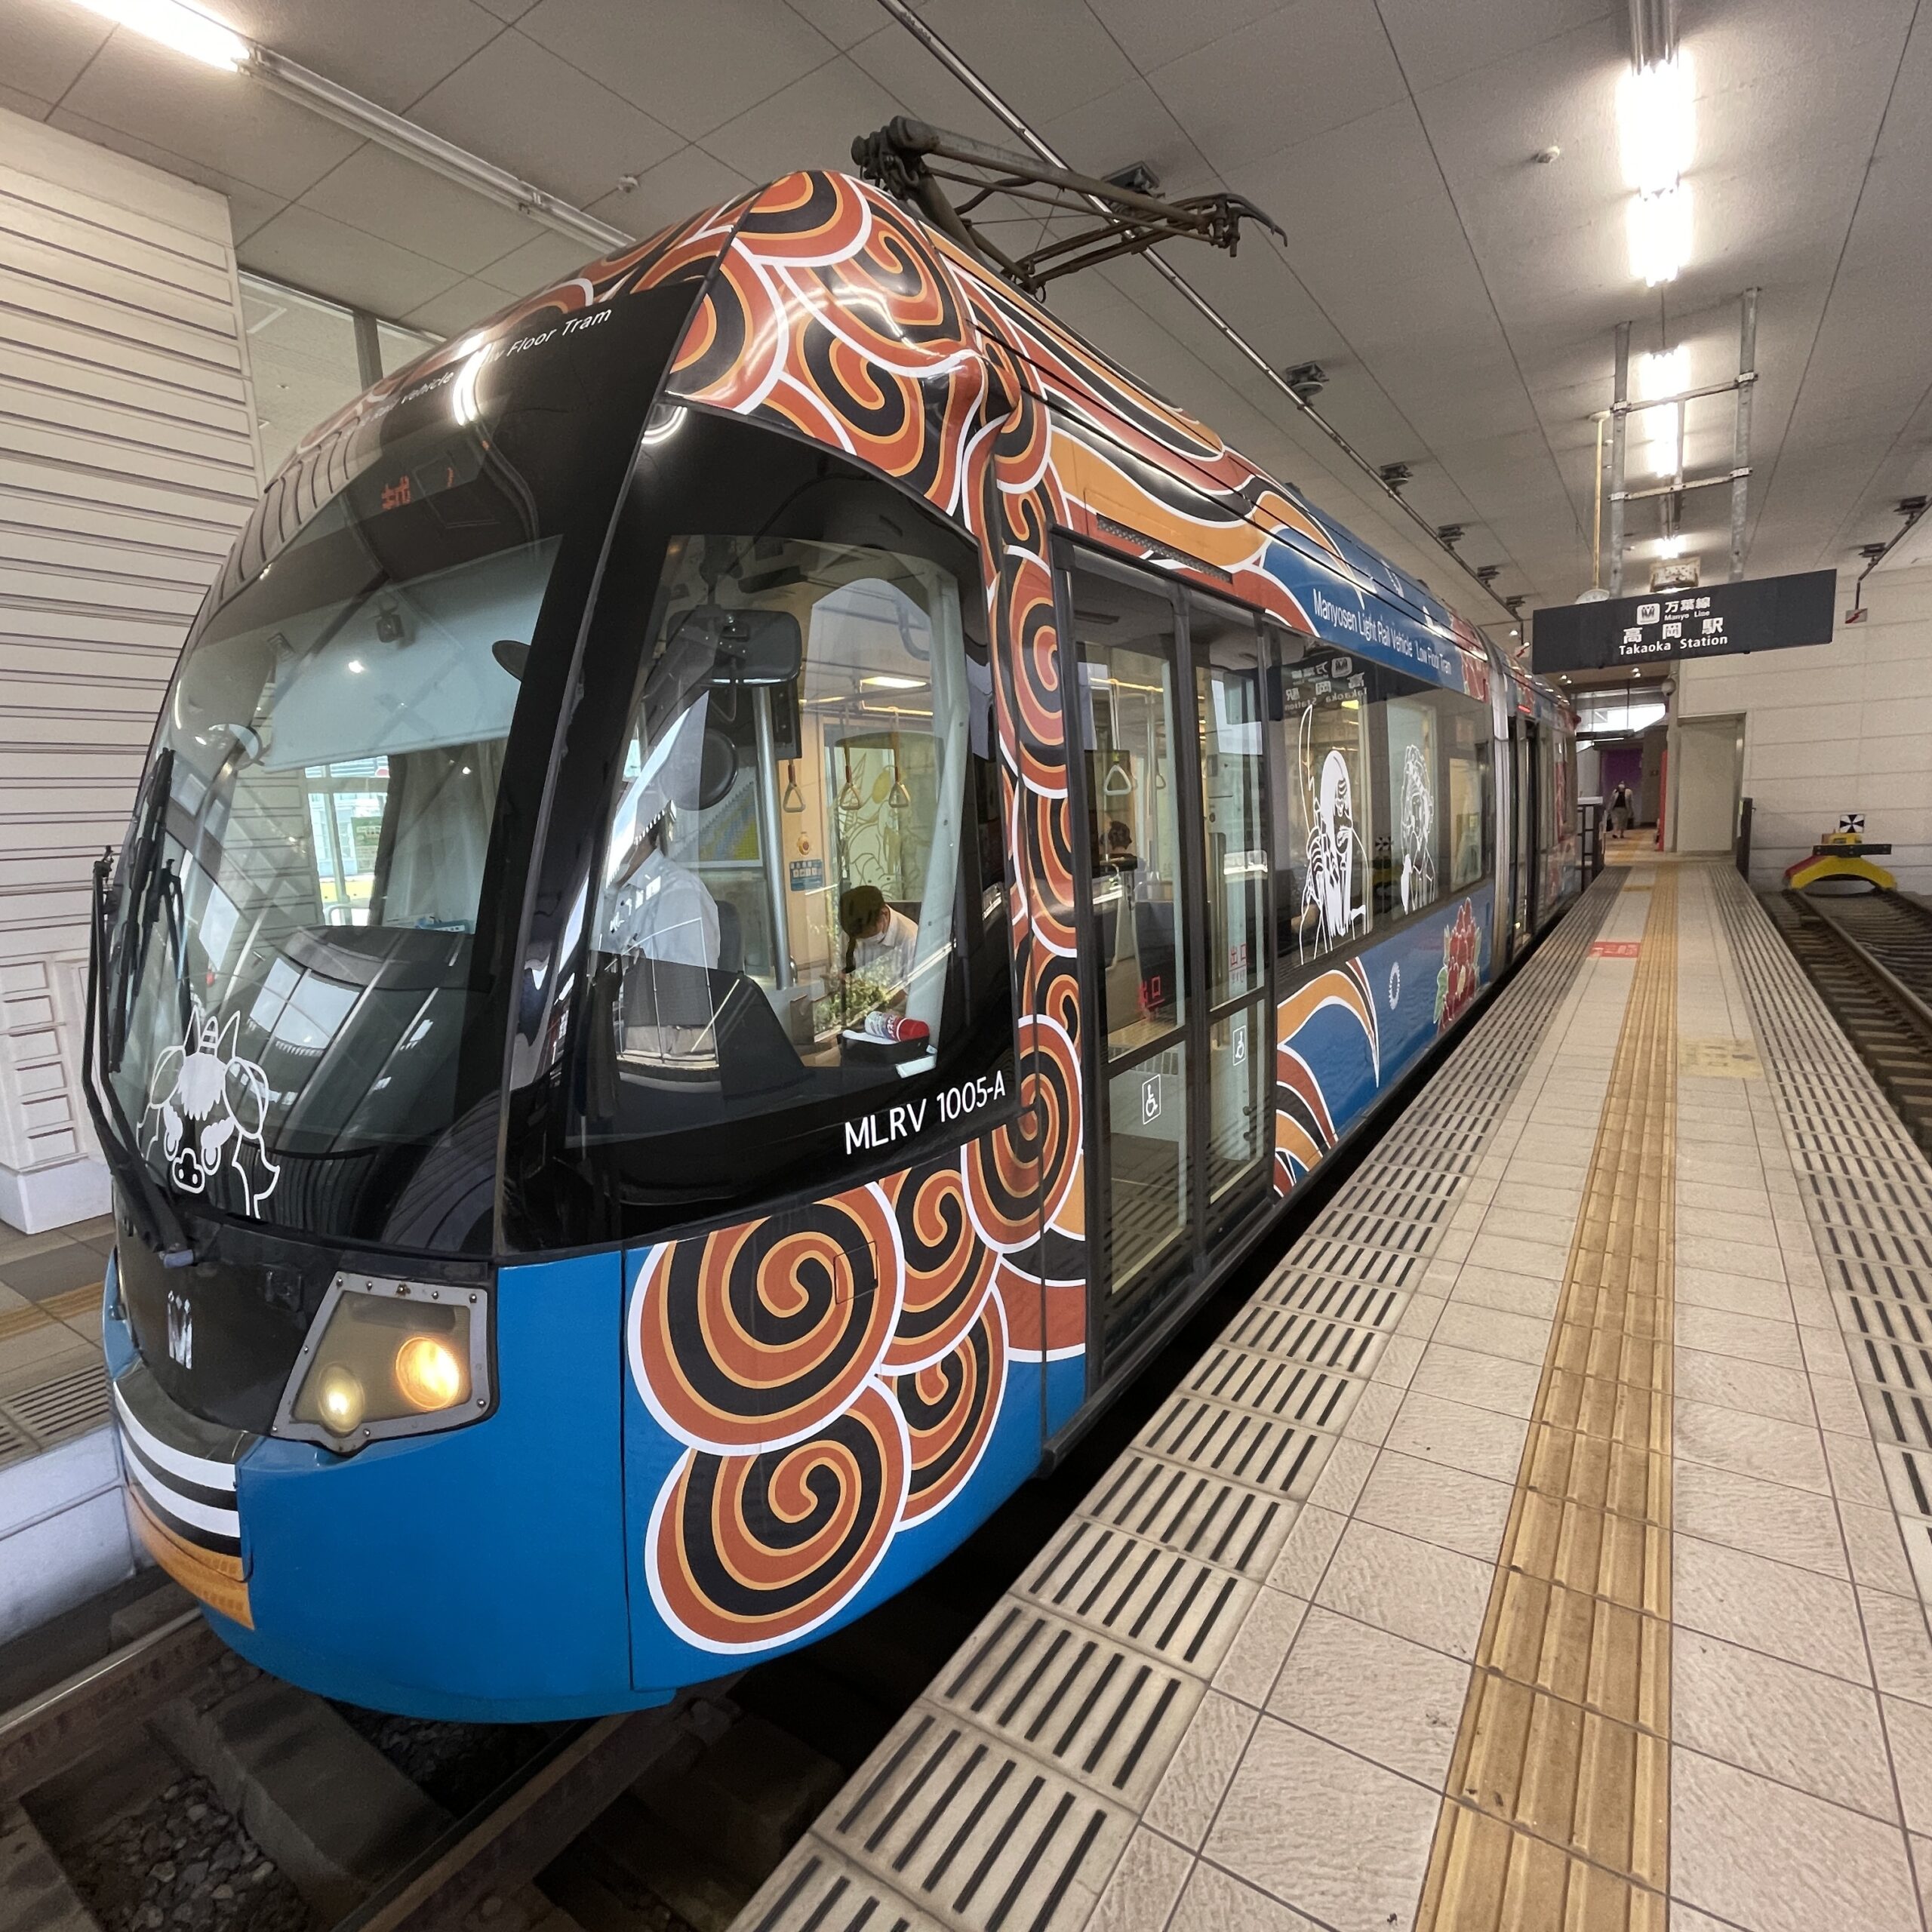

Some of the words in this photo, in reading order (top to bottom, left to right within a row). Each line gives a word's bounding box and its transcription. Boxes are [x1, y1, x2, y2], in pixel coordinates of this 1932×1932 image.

[506, 329, 557, 357] Floor
[562, 309, 612, 336] Tram
[1313, 588, 1358, 632] Manyosen
[1358, 611, 1377, 641] Light
[1377, 620, 1391, 648] Rail
[1664, 596, 1711, 614] 万葉線
[1664, 613, 1690, 621] Manyo
[1619, 640, 1672, 656] Takaoka
[1679, 635, 1728, 649] Station
[844, 1098, 928, 1155] MLRV
[936, 1069, 1006, 1123] 1005-A
